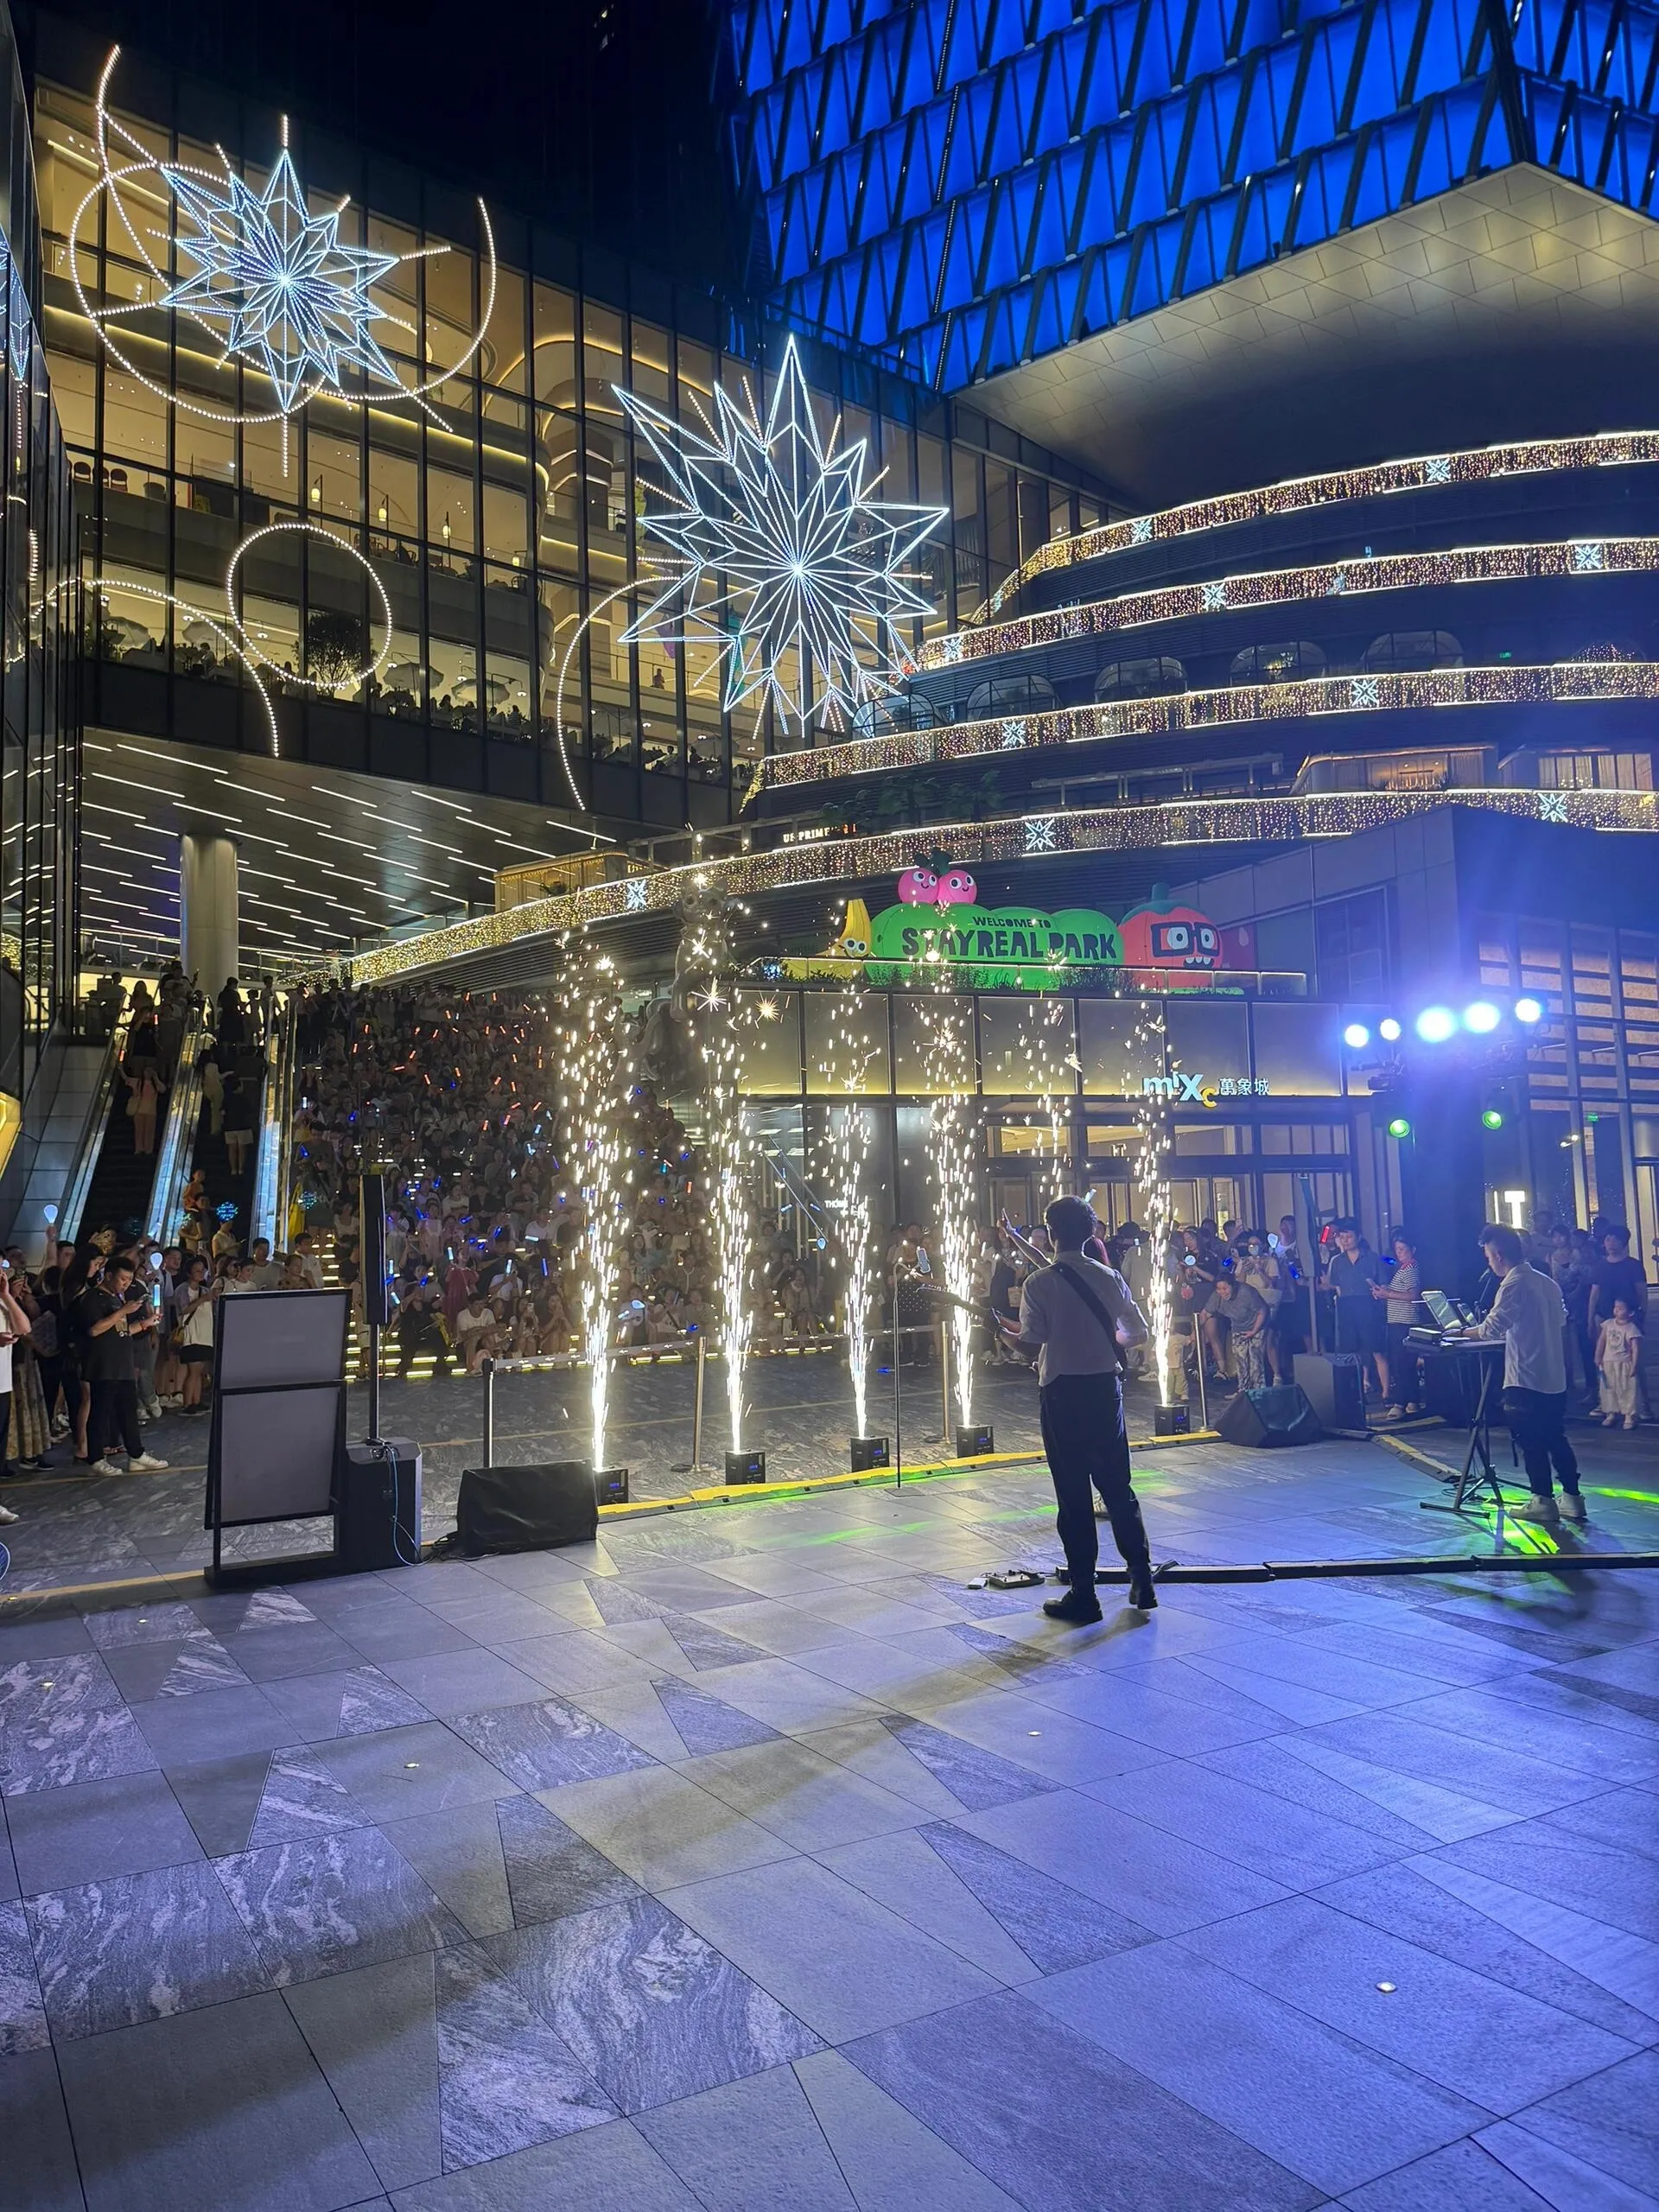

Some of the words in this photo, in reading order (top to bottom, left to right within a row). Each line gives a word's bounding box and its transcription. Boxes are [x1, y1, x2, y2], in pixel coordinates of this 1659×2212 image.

[973, 916, 1033, 929] WELCOME
[1037, 918, 1052, 929] TO
[901, 927, 1044, 958] STAYREAL
[1048, 931, 1117, 961] PARK
[1219, 1077, 1270, 1096] 萬象城
